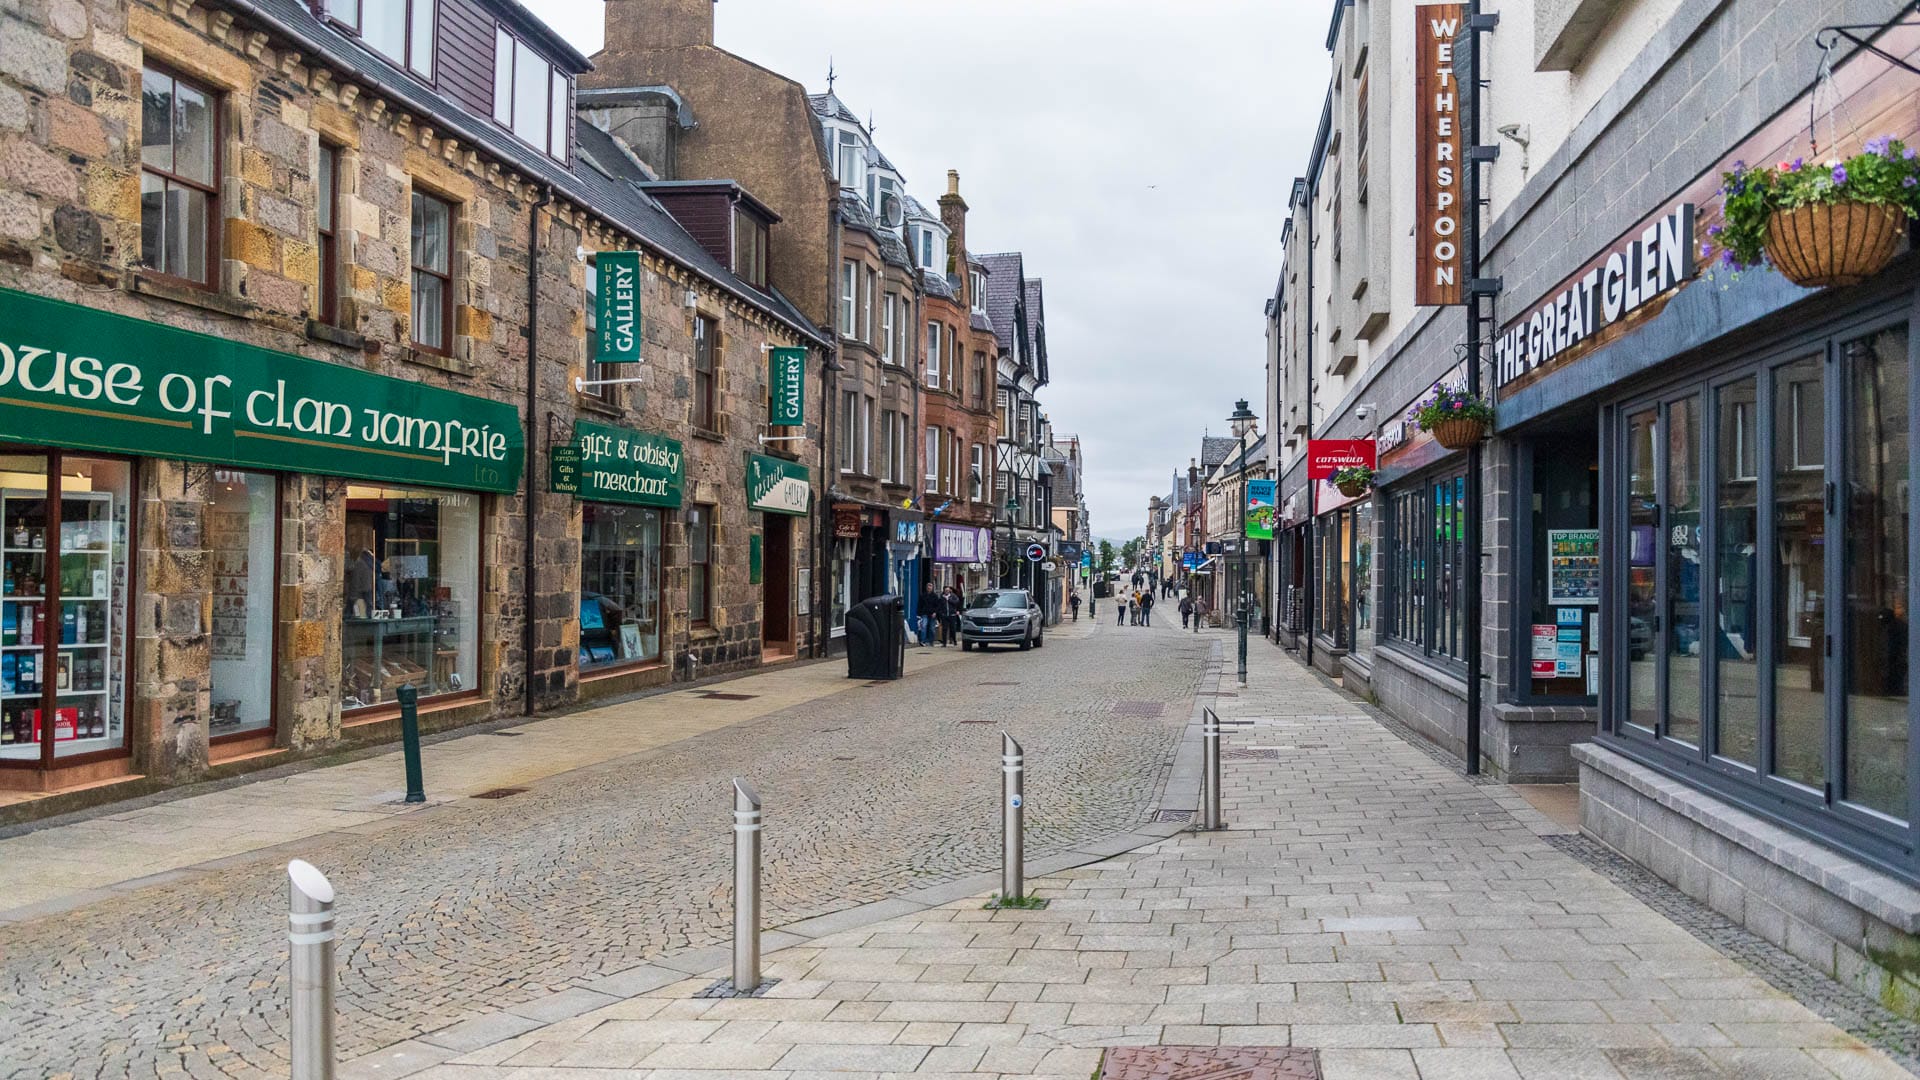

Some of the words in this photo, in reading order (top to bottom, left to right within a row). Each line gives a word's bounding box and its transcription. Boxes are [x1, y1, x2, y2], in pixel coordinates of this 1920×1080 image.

[1431, 18, 1457, 286] WETHERSPOON
[604, 263, 612, 352] UPSTAIRS
[616, 264, 634, 352] GALLERY
[1496, 321, 1529, 388] THE
[1527, 267, 1602, 369] GREAT
[1602, 203, 1691, 324] GLEN
[158, 373, 232, 435] of
[787, 355, 800, 418] GALLERY
[559, 465, 574, 473] Gifts
[581, 433, 612, 462] gift
[618, 439, 628, 459] &
[634, 442, 679, 474] whisky
[555, 483, 578, 492] Whisky
